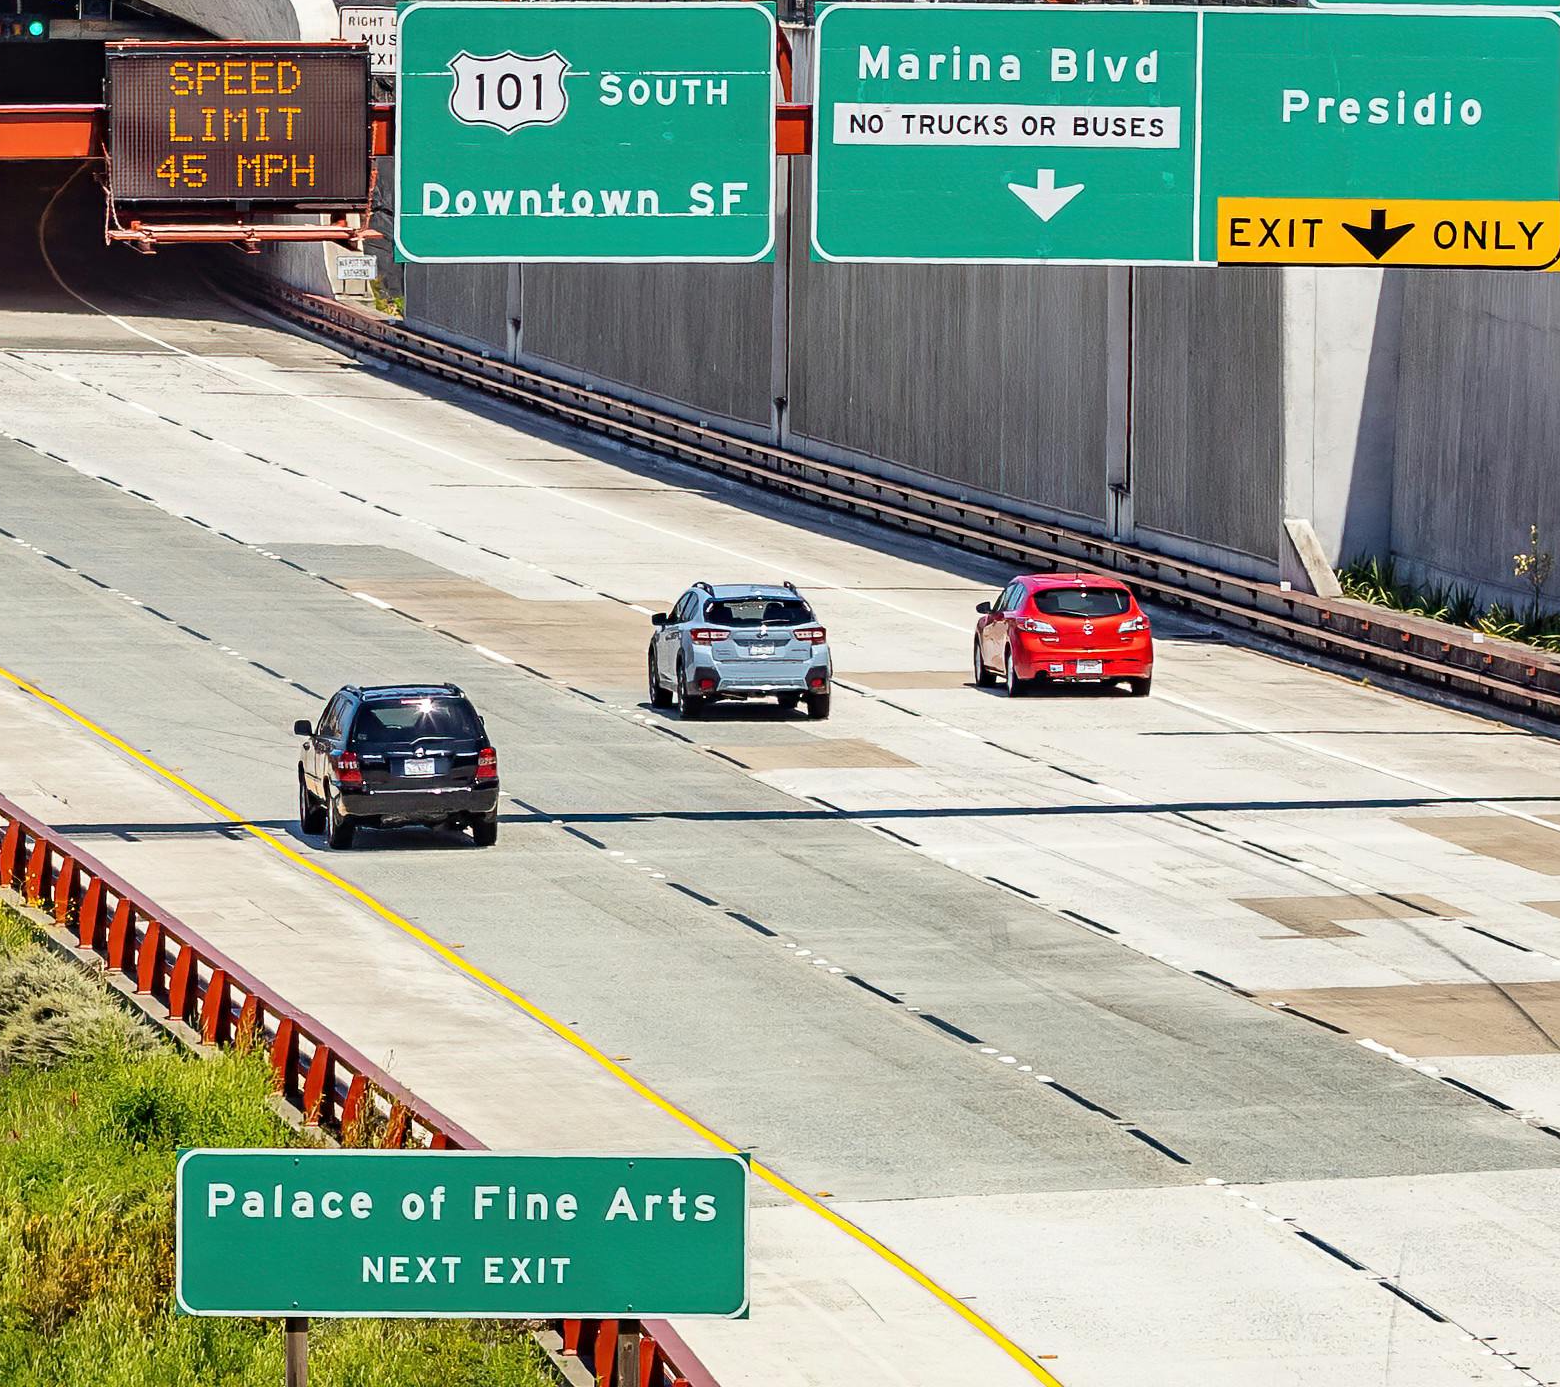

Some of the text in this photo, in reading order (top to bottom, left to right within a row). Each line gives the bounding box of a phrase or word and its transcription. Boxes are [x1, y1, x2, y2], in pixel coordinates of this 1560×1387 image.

[348, 16, 384, 27] RIGHT
[169, 61, 301, 95] SPEED
[857, 44, 1158, 83] Marina Blvd
[475, 72, 728, 111] 101 SOUTH
[1282, 89, 1482, 126] Presidio
[169, 107, 301, 142] LIMIT
[849, 114, 1164, 138] NO TRUCKS OR BUSES
[156, 154, 315, 188] 45 MPH
[422, 182, 748, 217] Downtown SF
[1229, 218, 1545, 250] EXIT ONLY
[206, 1183, 717, 1222] Palace of Fine Arts
[361, 1255, 571, 1285] NEXT EXIT
